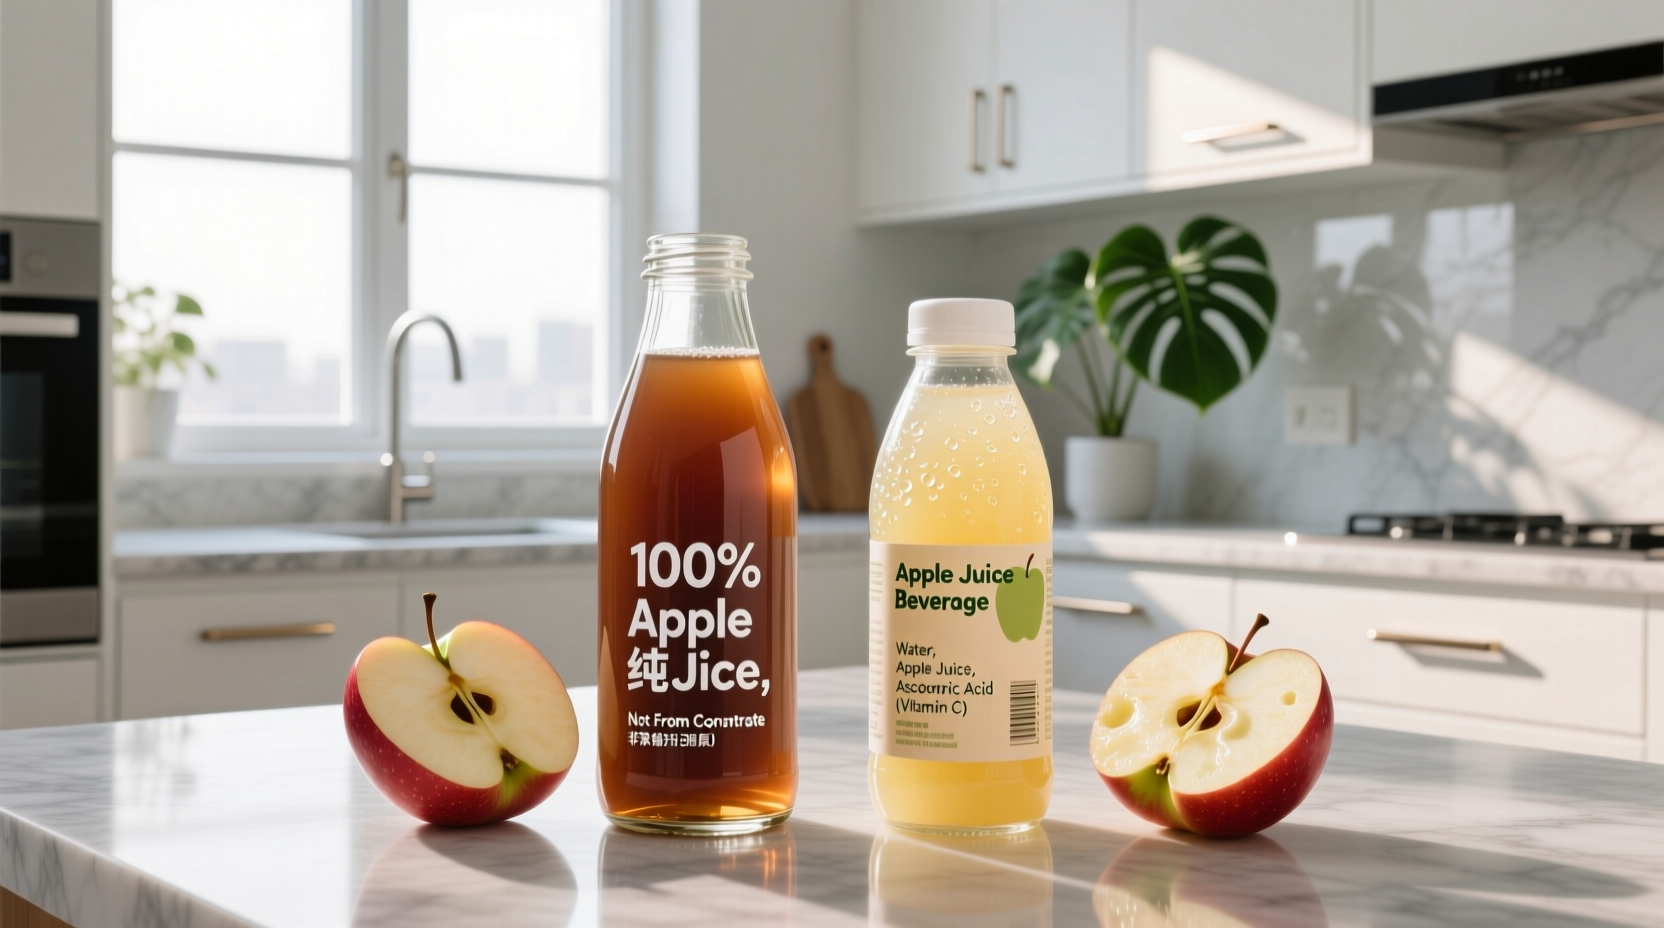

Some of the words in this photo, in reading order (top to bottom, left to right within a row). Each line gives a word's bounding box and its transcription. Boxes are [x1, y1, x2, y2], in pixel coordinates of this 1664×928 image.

[630, 541, 762, 588] 100%
[895, 562, 954, 589] Apple
[958, 563, 1015, 584] Juice
[895, 588, 990, 617] Beverage
[627, 597, 753, 649] Apple
[896, 641, 936, 659] Water,
[896, 660, 932, 678] Apple
[936, 661, 976, 678] Juice,
[963, 680, 994, 695] Acid
[951, 700, 968, 718] C)
[628, 710, 651, 727] Not
[654, 712, 690, 728] From
